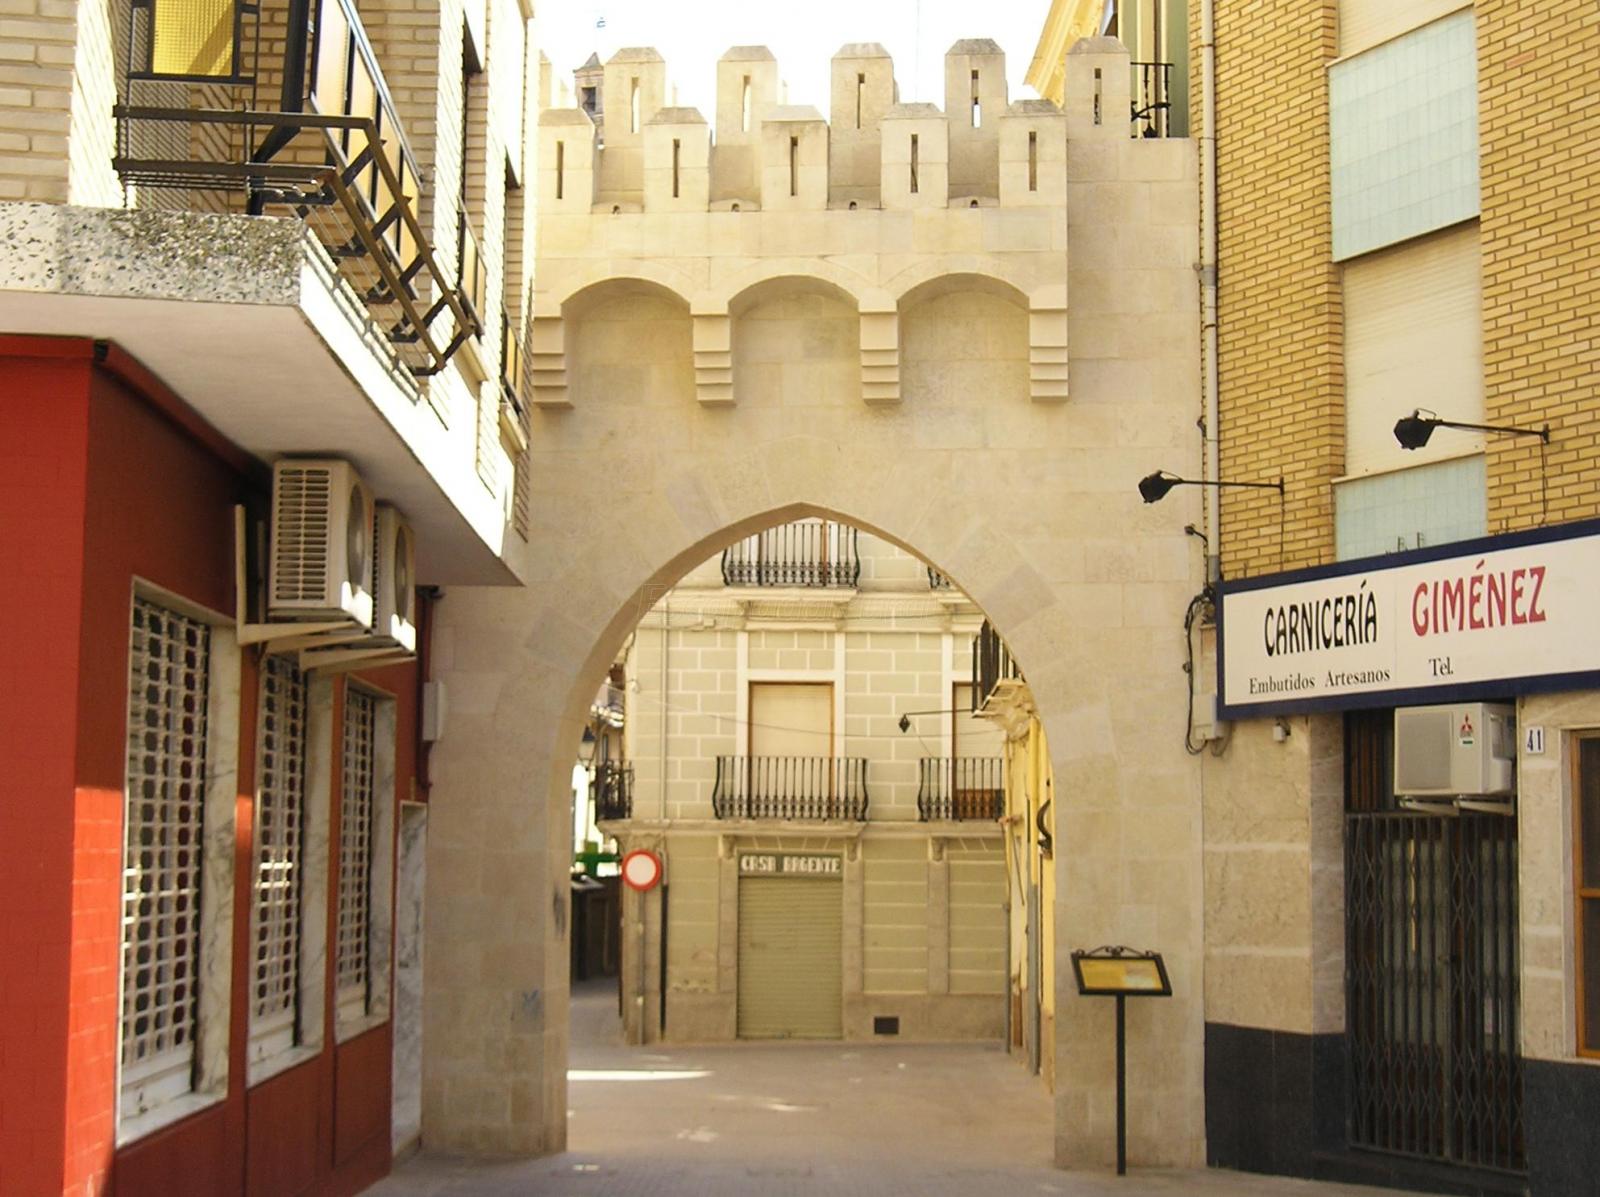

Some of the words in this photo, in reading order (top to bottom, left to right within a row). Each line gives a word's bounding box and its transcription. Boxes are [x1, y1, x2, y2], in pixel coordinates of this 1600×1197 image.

[1264, 579, 1378, 657] CARNICERÍA
[1412, 558, 1547, 637] GIMÉNEZ
[1428, 656, 1454, 677] Tel.
[1249, 672, 1316, 695] Embutidos
[1324, 668, 1392, 688] Artesanos
[1526, 729, 1542, 751] 41
[741, 855, 776, 872] CASA
